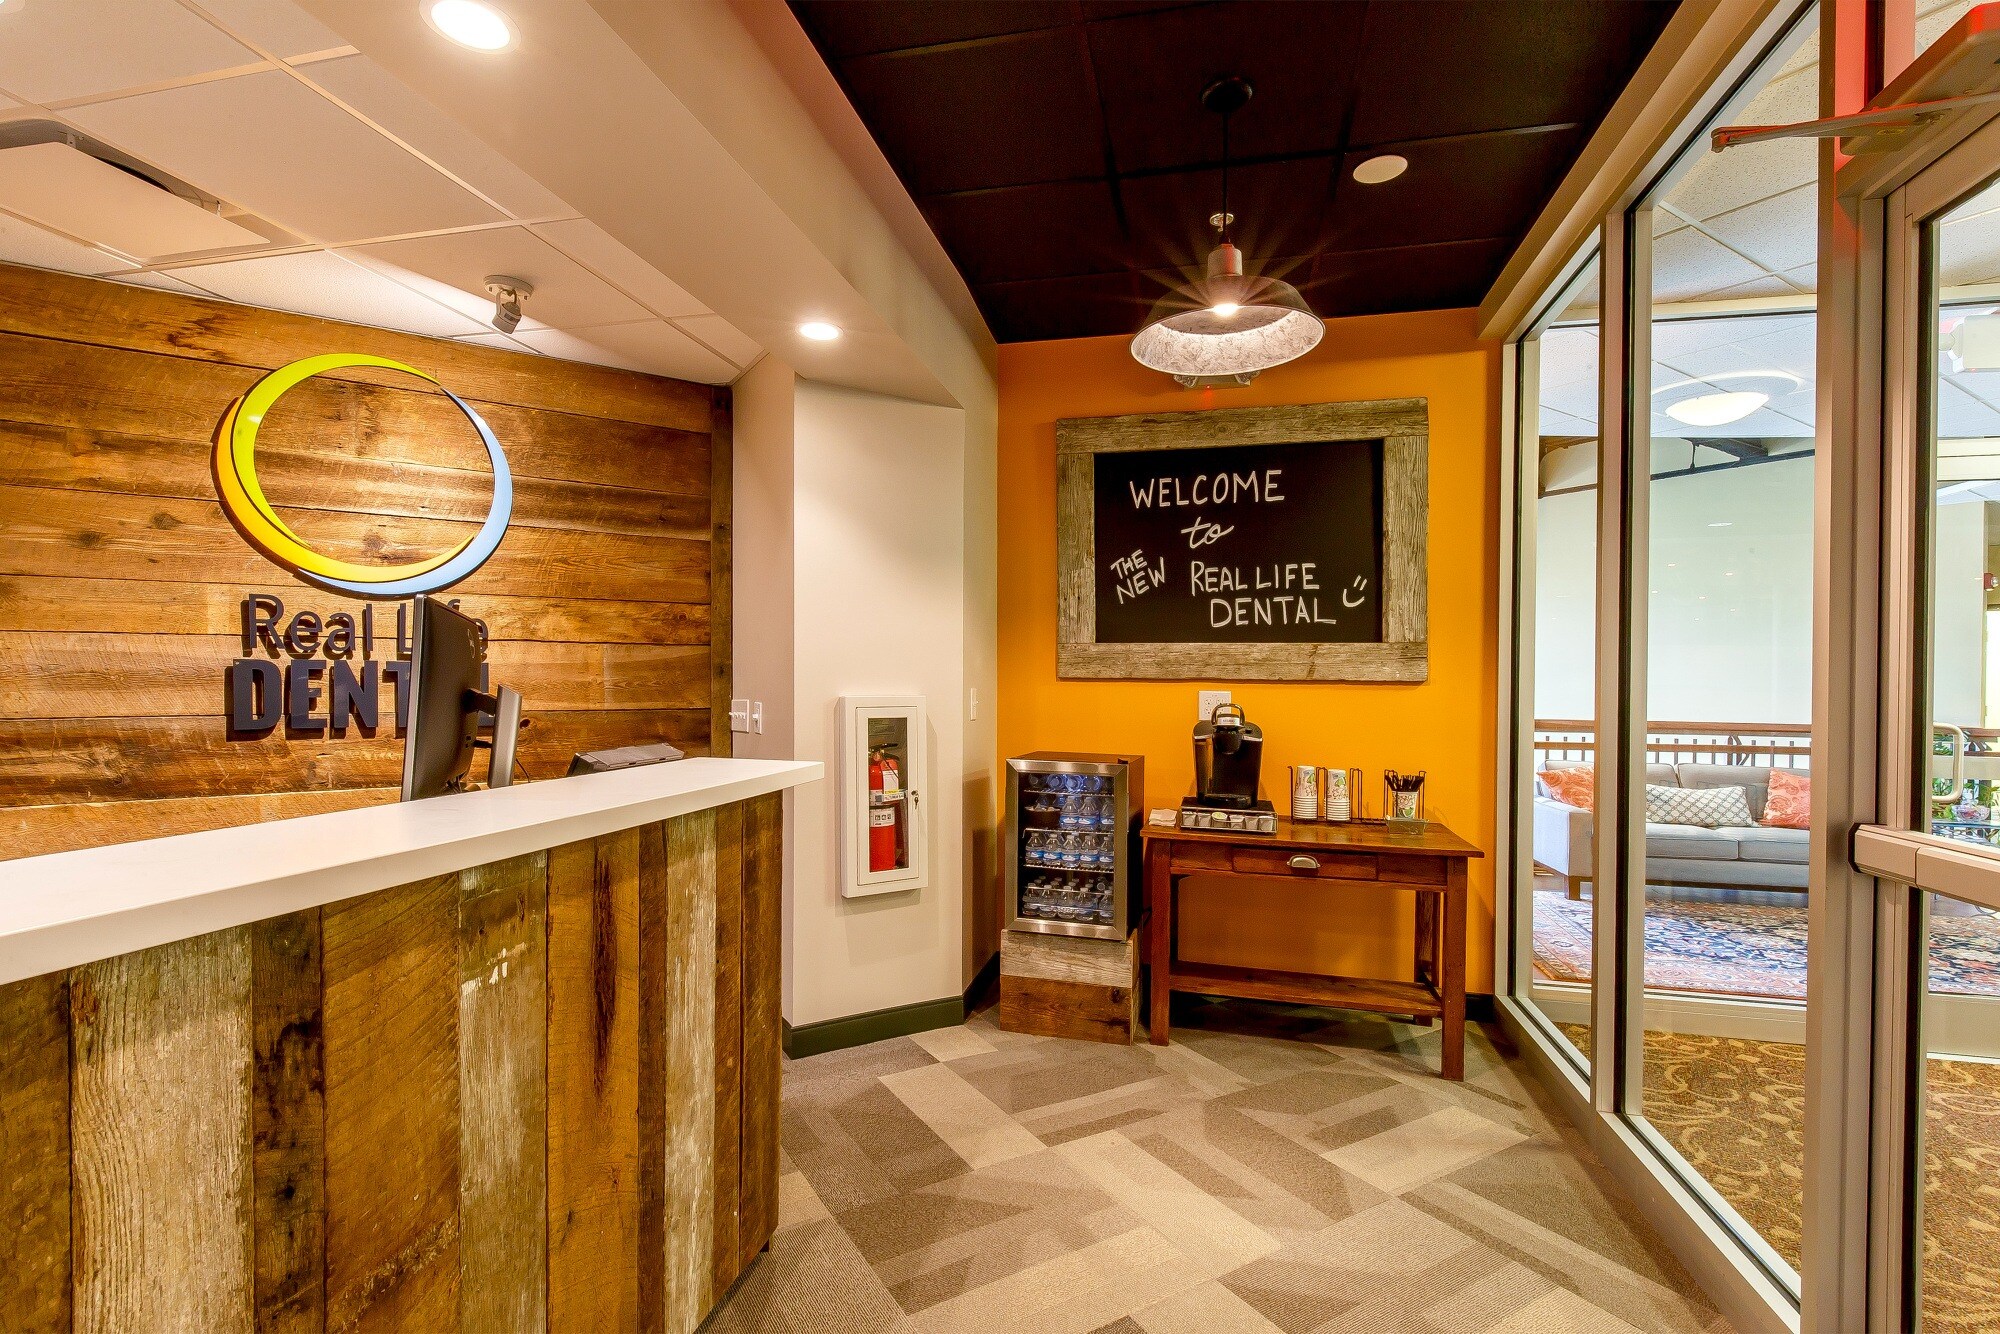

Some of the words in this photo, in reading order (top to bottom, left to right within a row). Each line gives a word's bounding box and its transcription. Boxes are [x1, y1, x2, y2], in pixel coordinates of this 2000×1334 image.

[1129, 469, 1285, 509] WELCOME
[1180, 516, 1235, 549] to
[1110, 549, 1148, 580] THE
[1116, 556, 1166, 605] NEW
[1191, 560, 1248, 597] REAL
[1256, 562, 1320, 591] LIFE
[248, 593, 373, 652] Real
[1211, 595, 1337, 628] DENTAL
[232, 658, 496, 731] DENT
